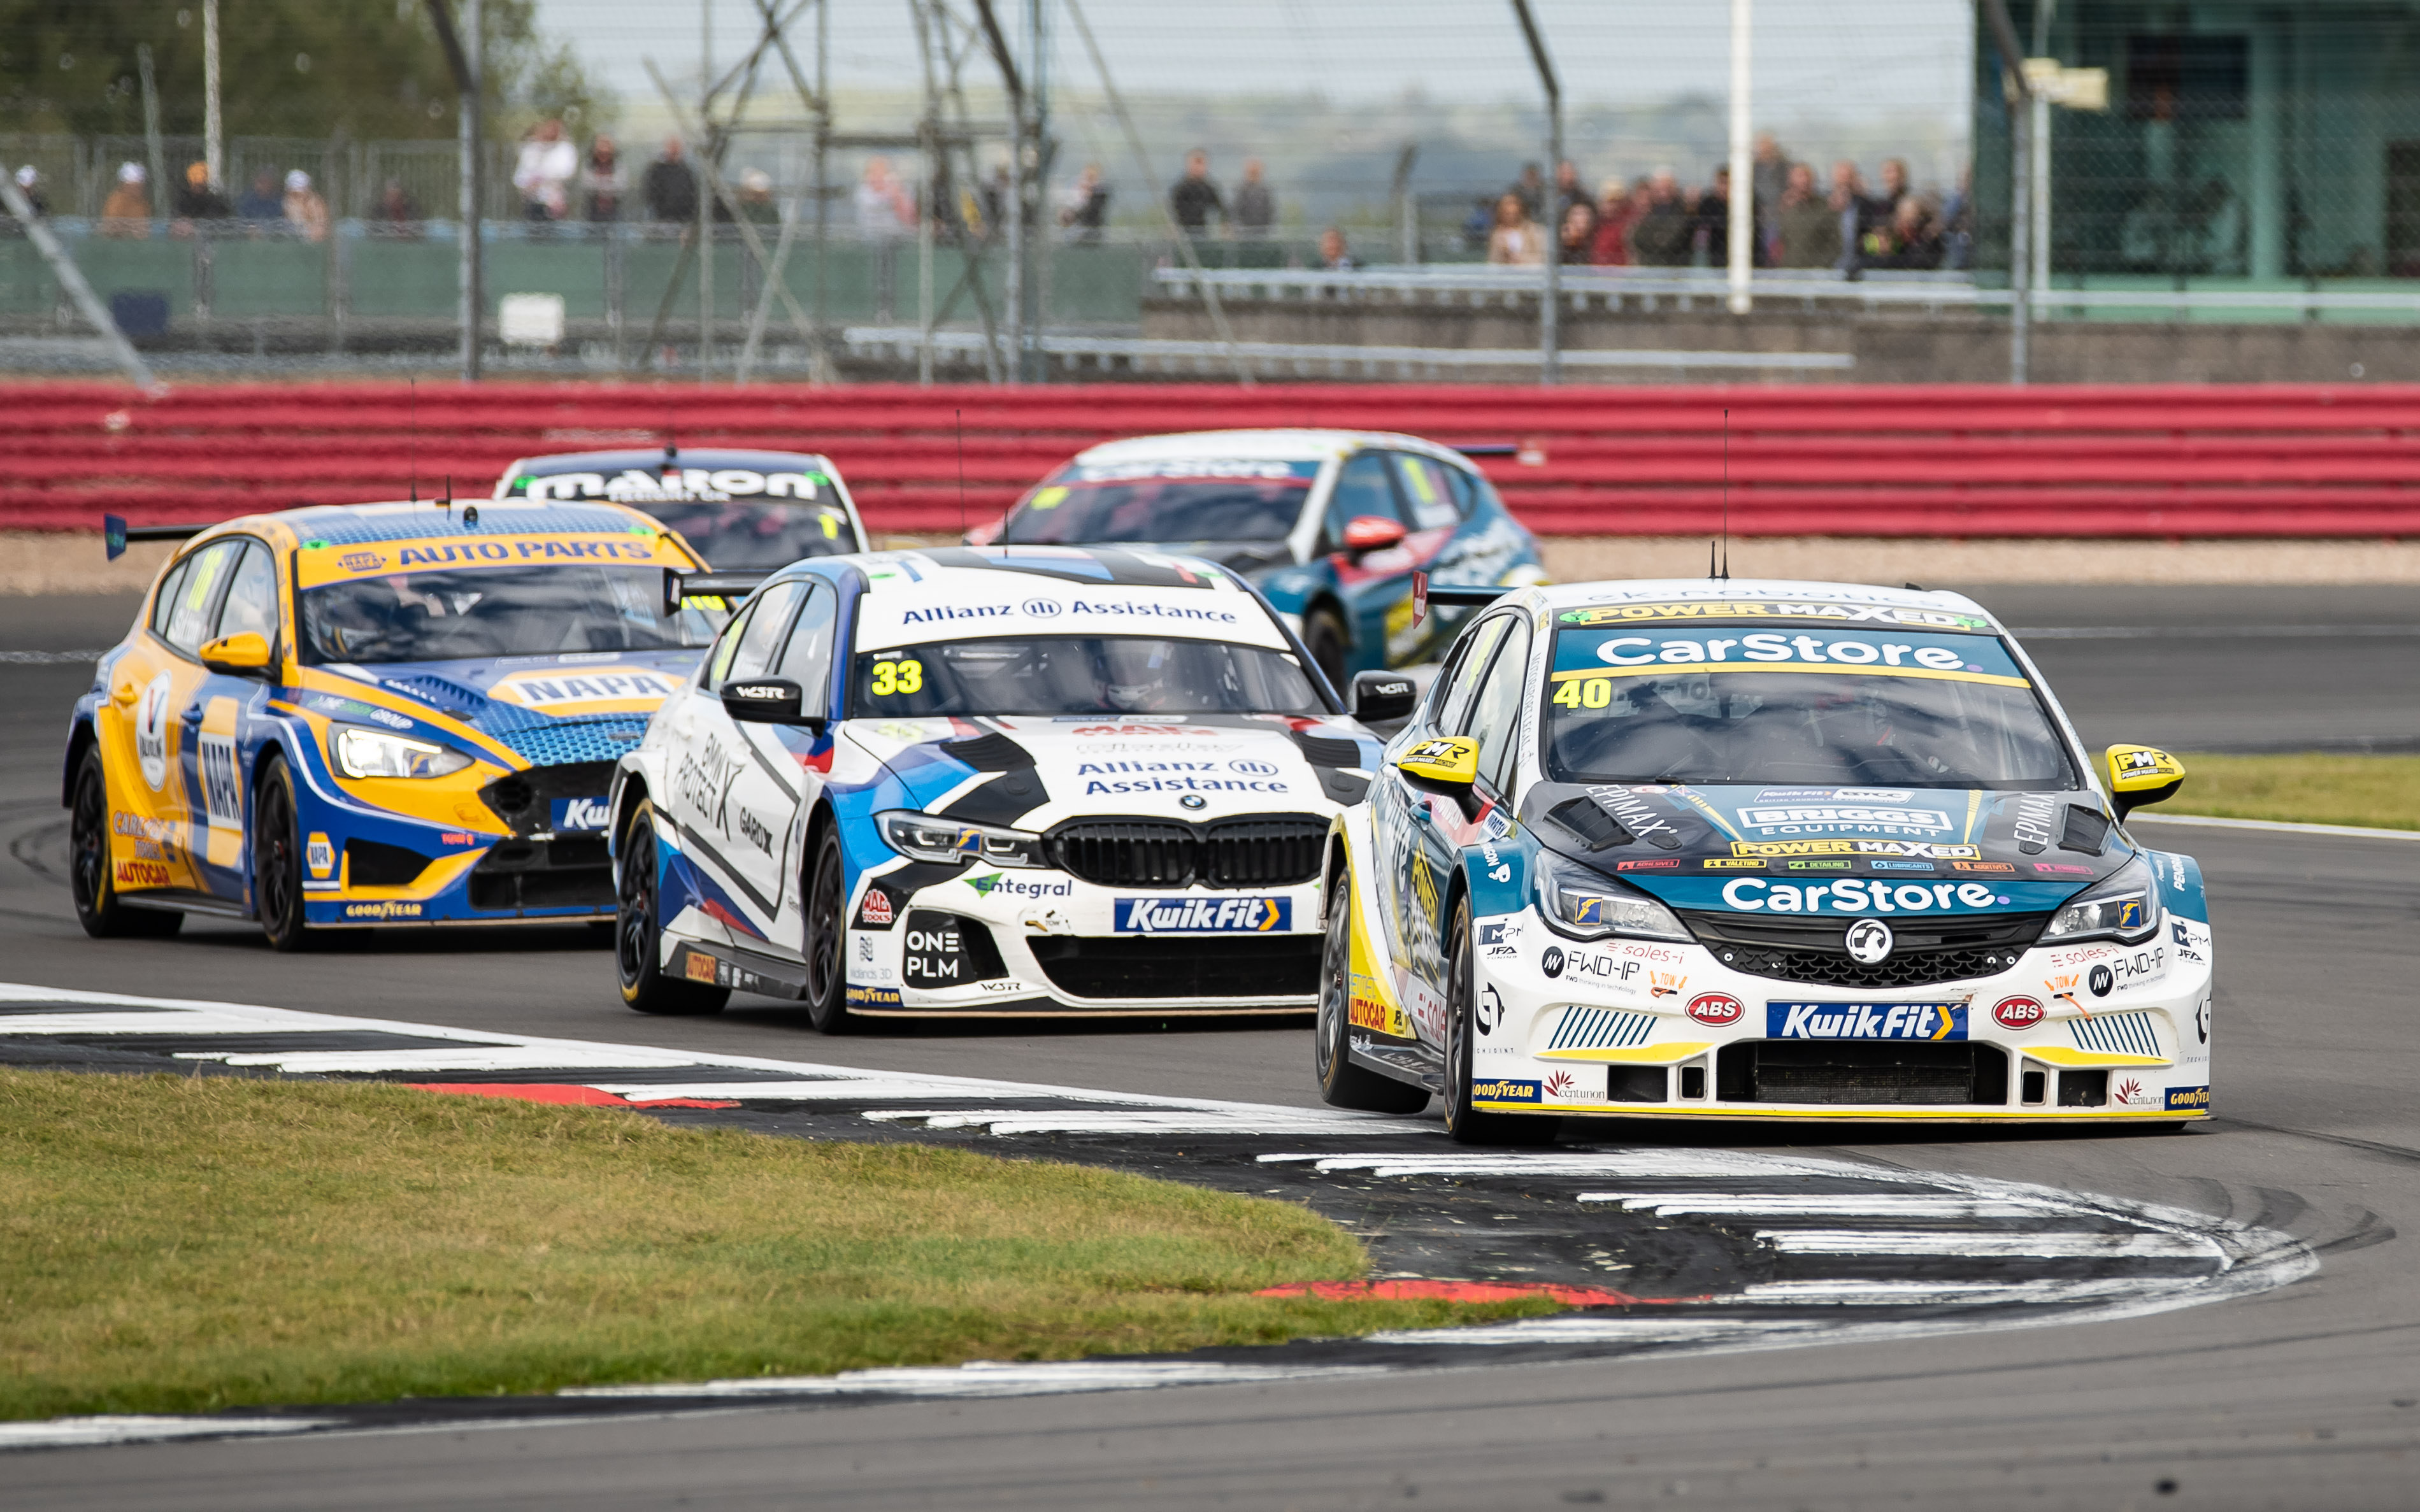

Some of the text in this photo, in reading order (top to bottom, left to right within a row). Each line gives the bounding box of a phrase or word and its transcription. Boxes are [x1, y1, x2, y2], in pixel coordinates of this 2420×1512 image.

[401, 543, 508, 565] AUTO
[515, 541, 652, 559] PARTS
[903, 601, 1237, 625] Allianz Assistance
[1590, 603, 1959, 625] POWER MAXED
[871, 660, 922, 696] 33
[519, 676, 670, 701] NAPA
[1552, 678, 1612, 709] 40
[1409, 741, 1470, 760] PMR
[1078, 760, 1219, 776] Allianz
[2116, 751, 2171, 771] PMR
[201, 742, 241, 820] NAPA
[1086, 777, 1289, 795] Assistance
[1585, 784, 1672, 837] EPIMAX
[1752, 809, 1936, 825] BRIGGS
[2013, 793, 2056, 846] EPIMAX
[1761, 824, 1941, 838] EQUIPMENT
[1738, 840, 1973, 859] POWER MAXED
[116, 860, 173, 888] AUTOCAR
[1636, 860, 1674, 869] ADHESIVES
[1887, 862, 1931, 870] LUBRICANTS
[976, 878, 1073, 899] Entegral
[346, 901, 422, 918] GOODYEAR
[863, 891, 890, 912] MAC
[906, 931, 959, 952] ONE
[1487, 946, 1517, 955] JFA
[2065, 945, 2120, 965] sales-i
[2177, 948, 2203, 961] JFA
[880, 968, 892, 980] 3D
[907, 956, 959, 978] PLM
[1566, 974, 1578, 983] FWD
[1660, 972, 1677, 987] TOW
[2055, 974, 2070, 989] TOW
[2117, 983, 2128, 992] FWD
[1694, 1001, 1738, 1018] ABS
[2000, 1004, 2039, 1020] ABS
[1559, 1089, 1605, 1099] centurion
[2170, 1088, 2210, 1107] GOODYEA
